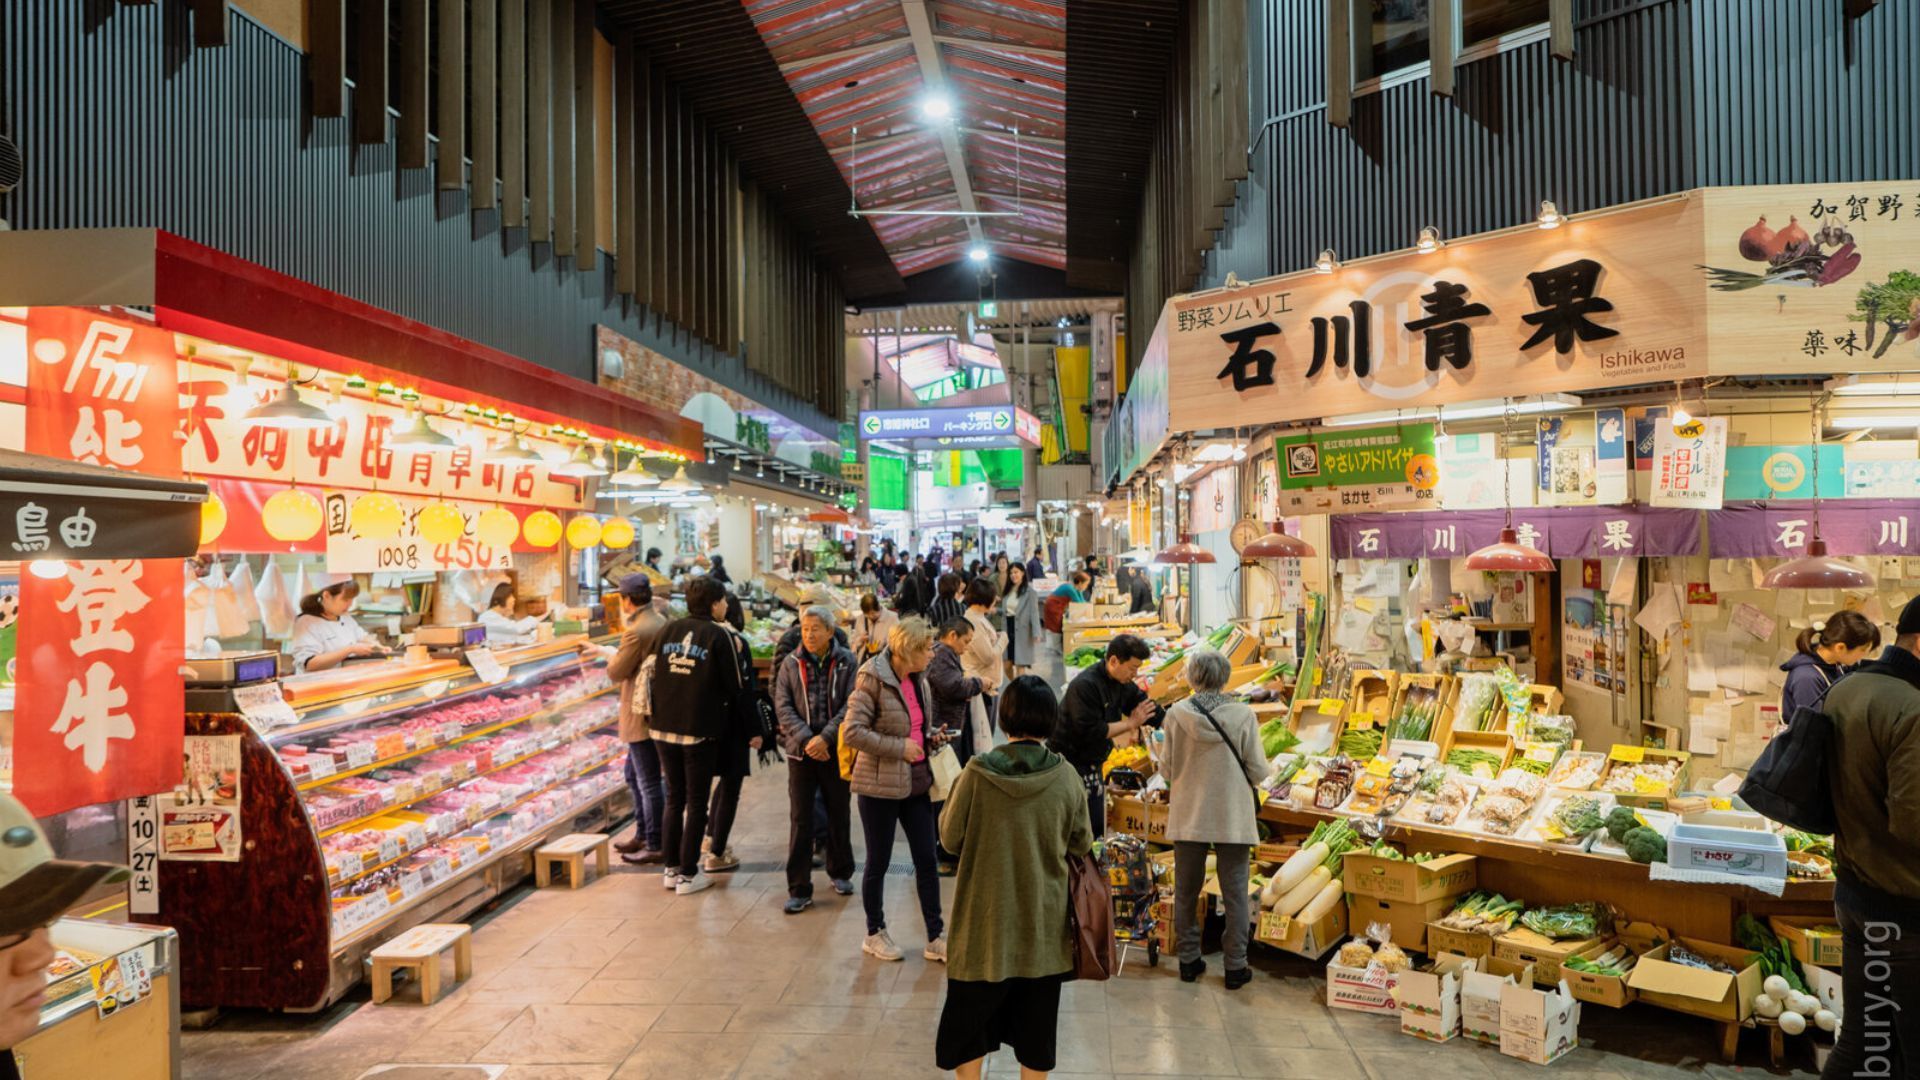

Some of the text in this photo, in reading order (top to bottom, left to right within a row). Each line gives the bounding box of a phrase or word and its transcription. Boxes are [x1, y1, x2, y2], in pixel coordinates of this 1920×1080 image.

[1177, 292, 1294, 333] 野菜ソムリエ
[1216, 258, 1622, 392] 石川青果
[1801, 329, 1863, 358] 薬味
[1600, 346, 1685, 369] Ishikawa
[1601, 360, 1686, 378] Vegetables and Fruits
[1415, 488, 1434, 500] の店
[1774, 515, 1909, 549] 石川
[1704, 850, 1734, 861] わさび
